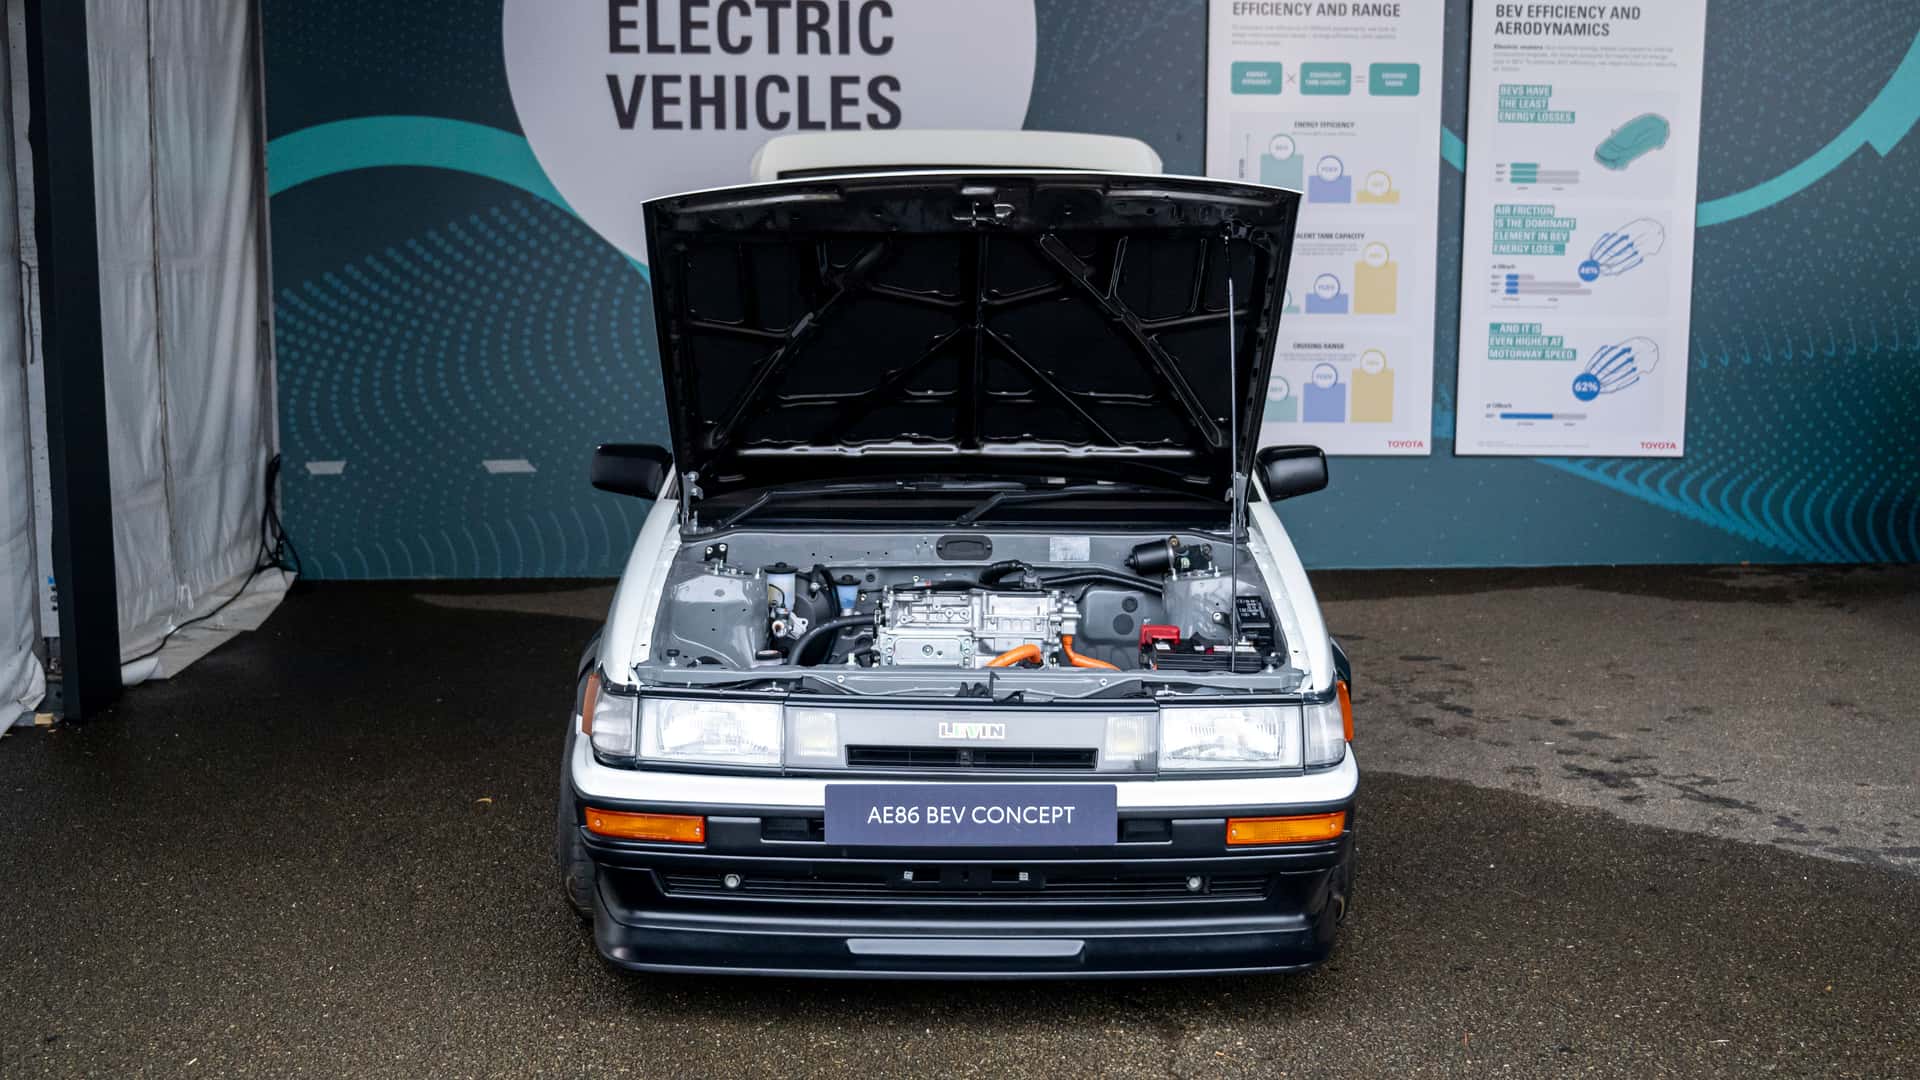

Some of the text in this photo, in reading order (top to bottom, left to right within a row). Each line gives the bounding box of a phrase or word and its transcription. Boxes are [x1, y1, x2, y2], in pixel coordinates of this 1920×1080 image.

[1232, 2, 1401, 18] EFFICIENCY AND RANGE
[1496, 4, 1641, 20] BEV EFFICIENCY AND
[609, 0, 895, 56] ELECTRIC
[1494, 21, 1610, 37] AERODYNAMICS
[606, 74, 902, 131] VEHICLES
[1575, 381, 1598, 392] 62%
[1388, 441, 1423, 449] TOYOTA
[1640, 441, 1677, 450] TOYOTA
[939, 722, 1005, 740] LEVIN
[867, 806, 1075, 825] AE86 BEV CONCEPT
